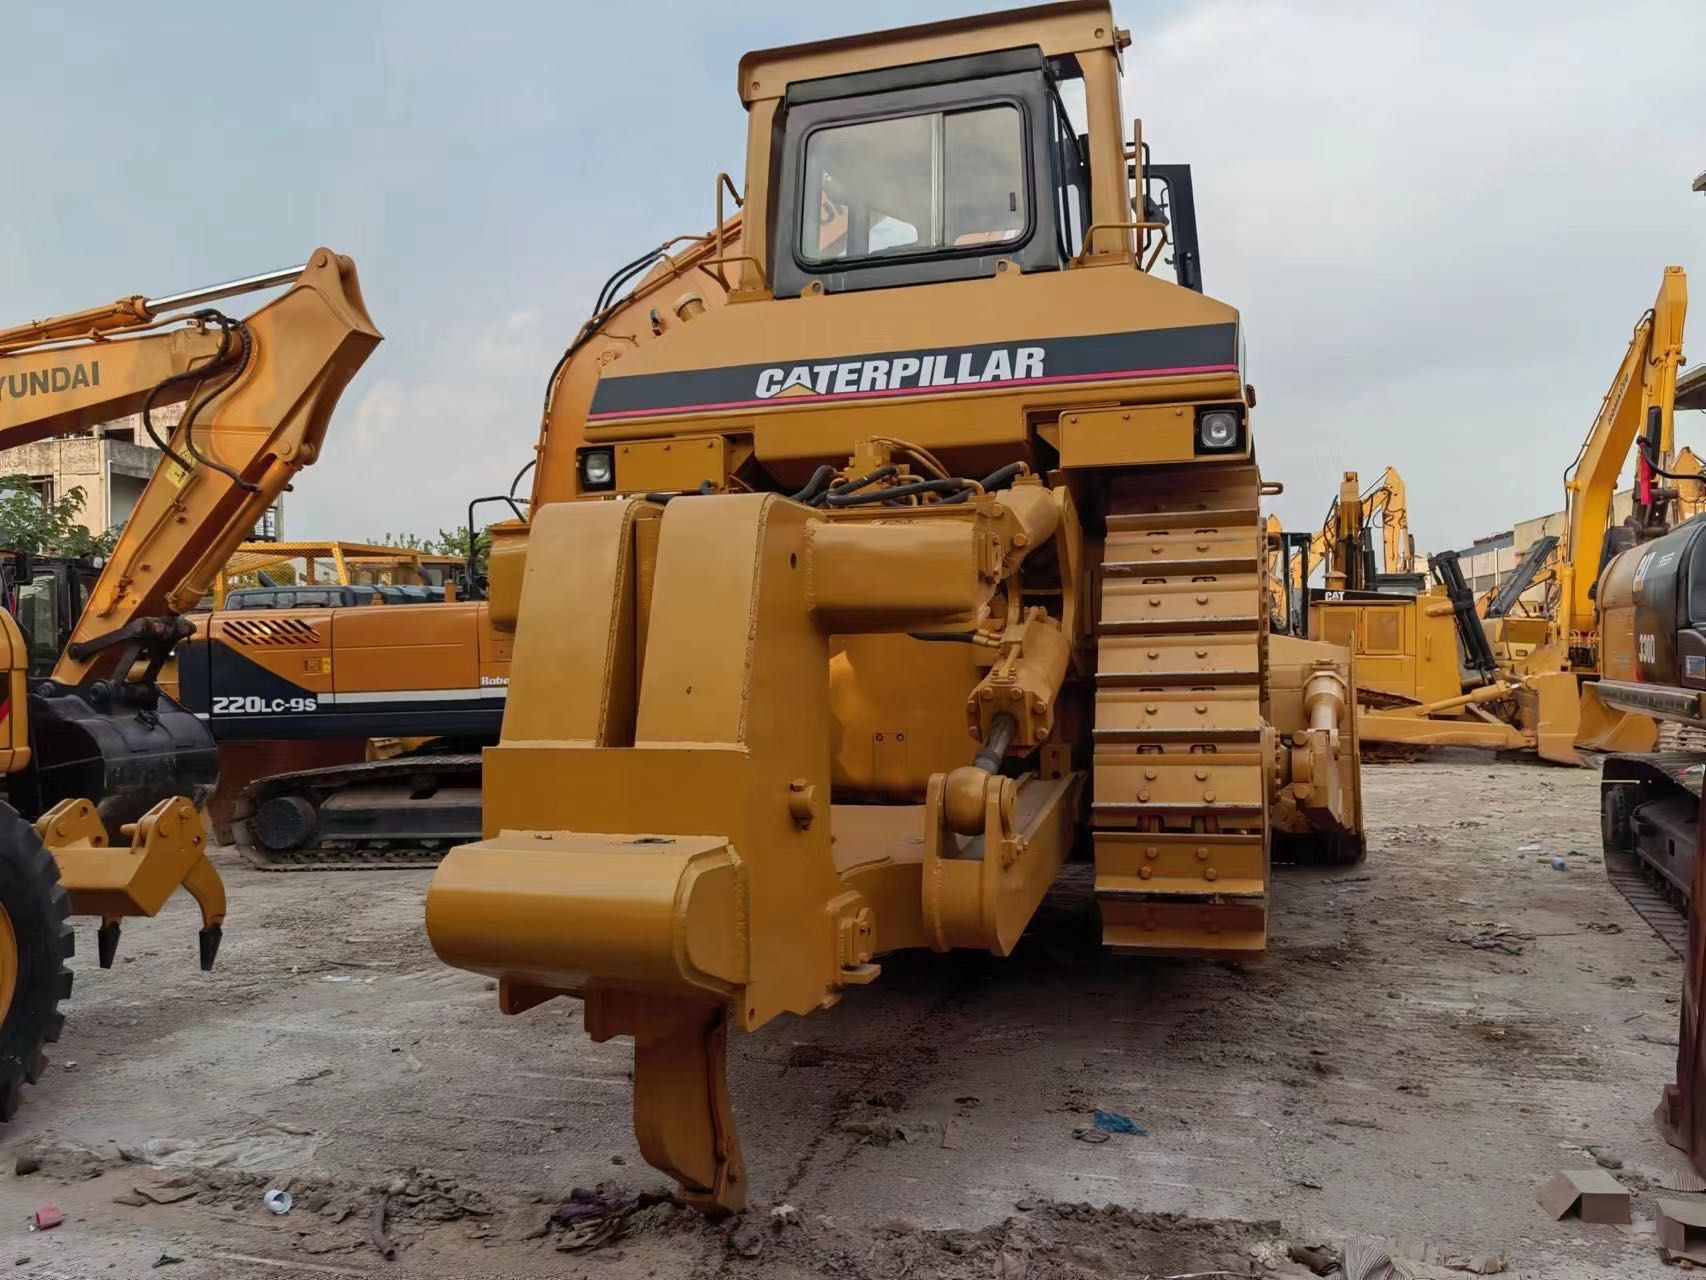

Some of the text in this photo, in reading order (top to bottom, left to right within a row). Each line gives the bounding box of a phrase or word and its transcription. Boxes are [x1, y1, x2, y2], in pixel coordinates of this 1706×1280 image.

[755, 347, 1045, 398] CATERPILLAR
[1325, 591, 1345, 602] CAT
[212, 696, 317, 713] 220LC-9S
